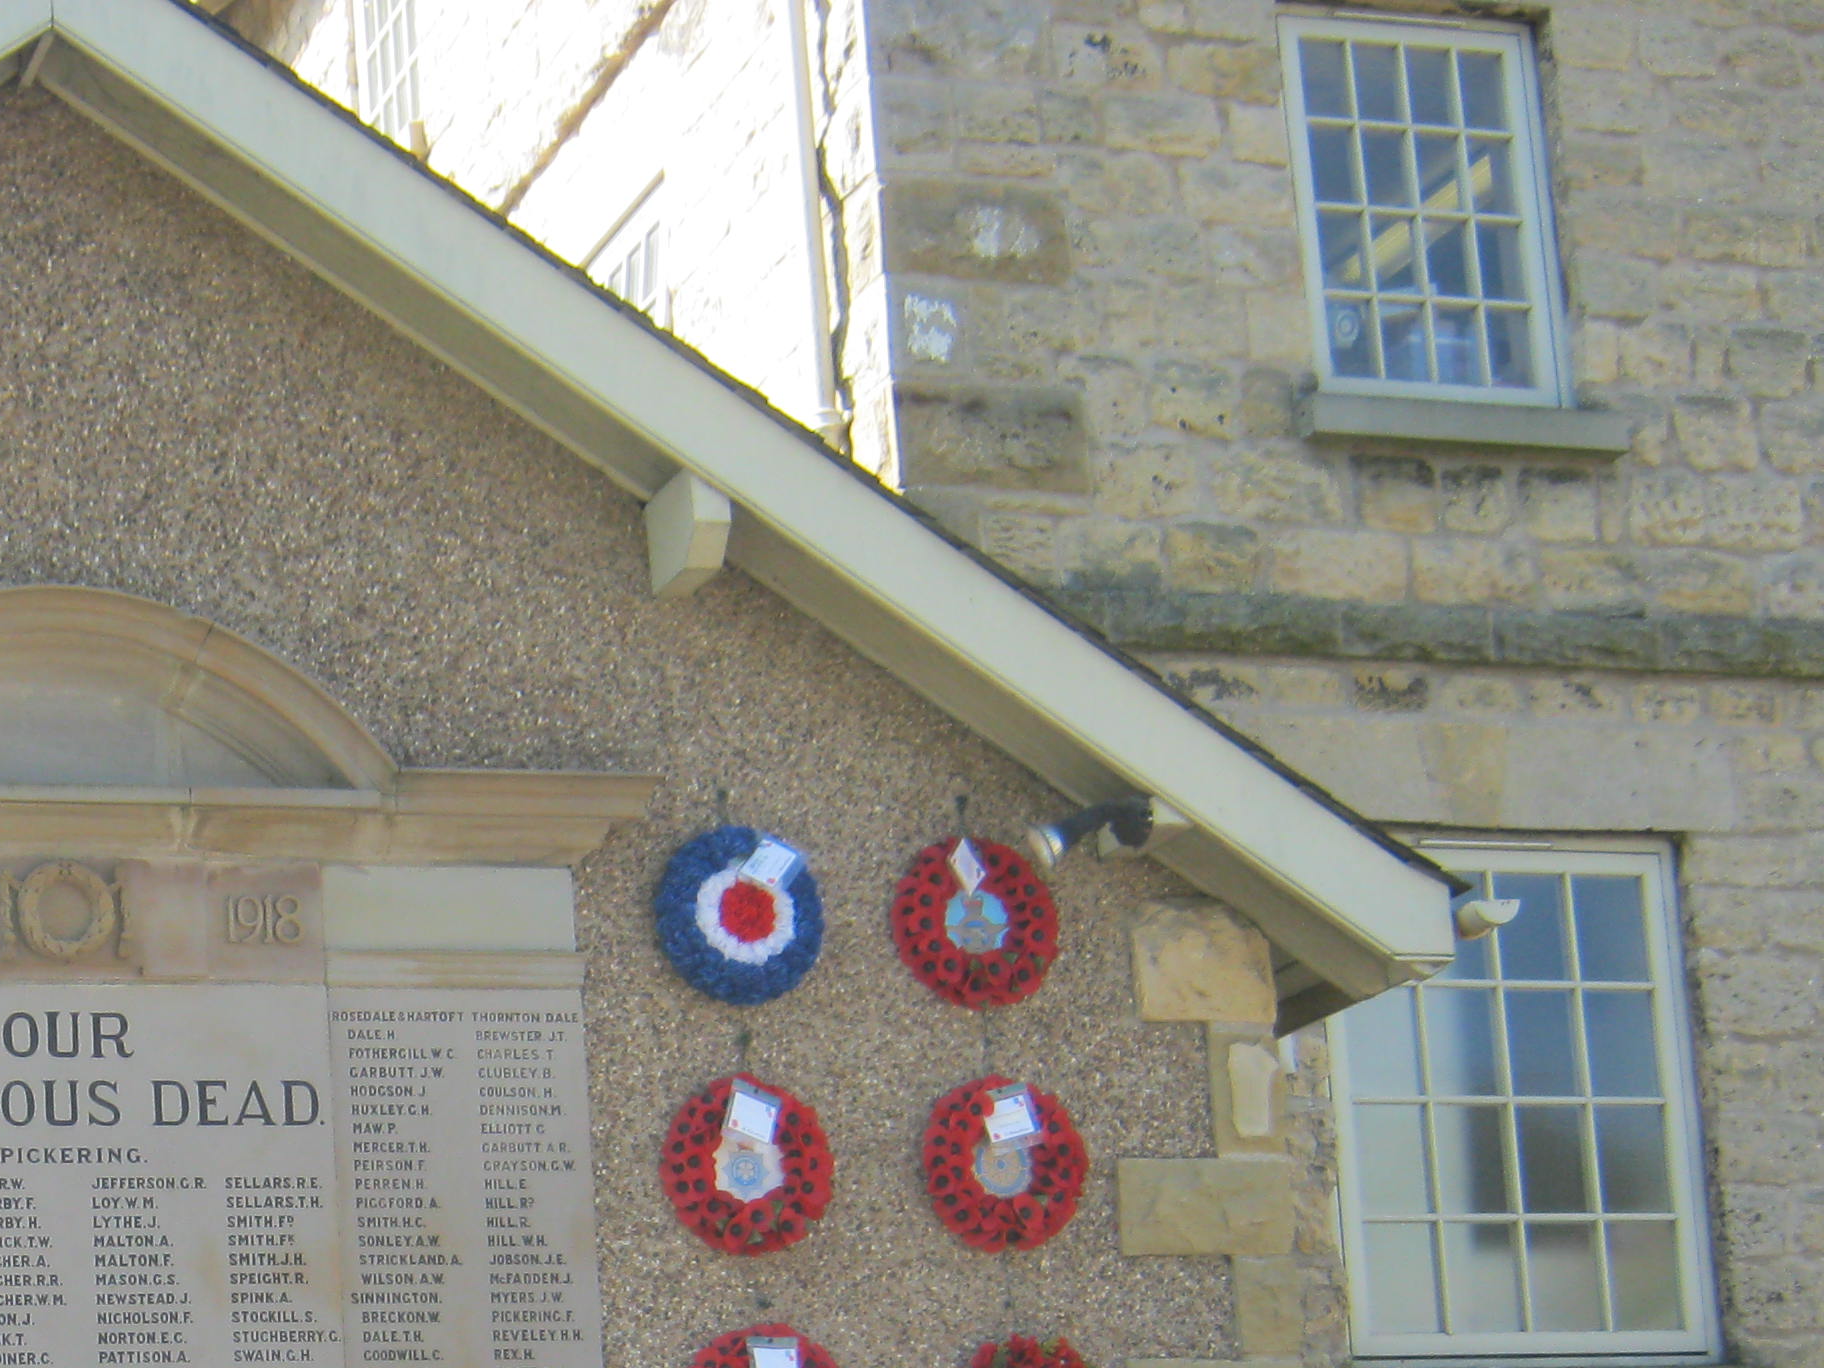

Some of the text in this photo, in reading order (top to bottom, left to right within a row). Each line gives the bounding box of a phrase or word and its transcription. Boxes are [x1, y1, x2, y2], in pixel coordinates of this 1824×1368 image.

[226, 895, 306, 944] 1918
[2, 1011, 135, 1058] OUR
[472, 1012, 578, 1023] THORNTON DALE
[152, 1080, 325, 1127] DEAD.
[0, 1148, 148, 1163] PICKERING.
